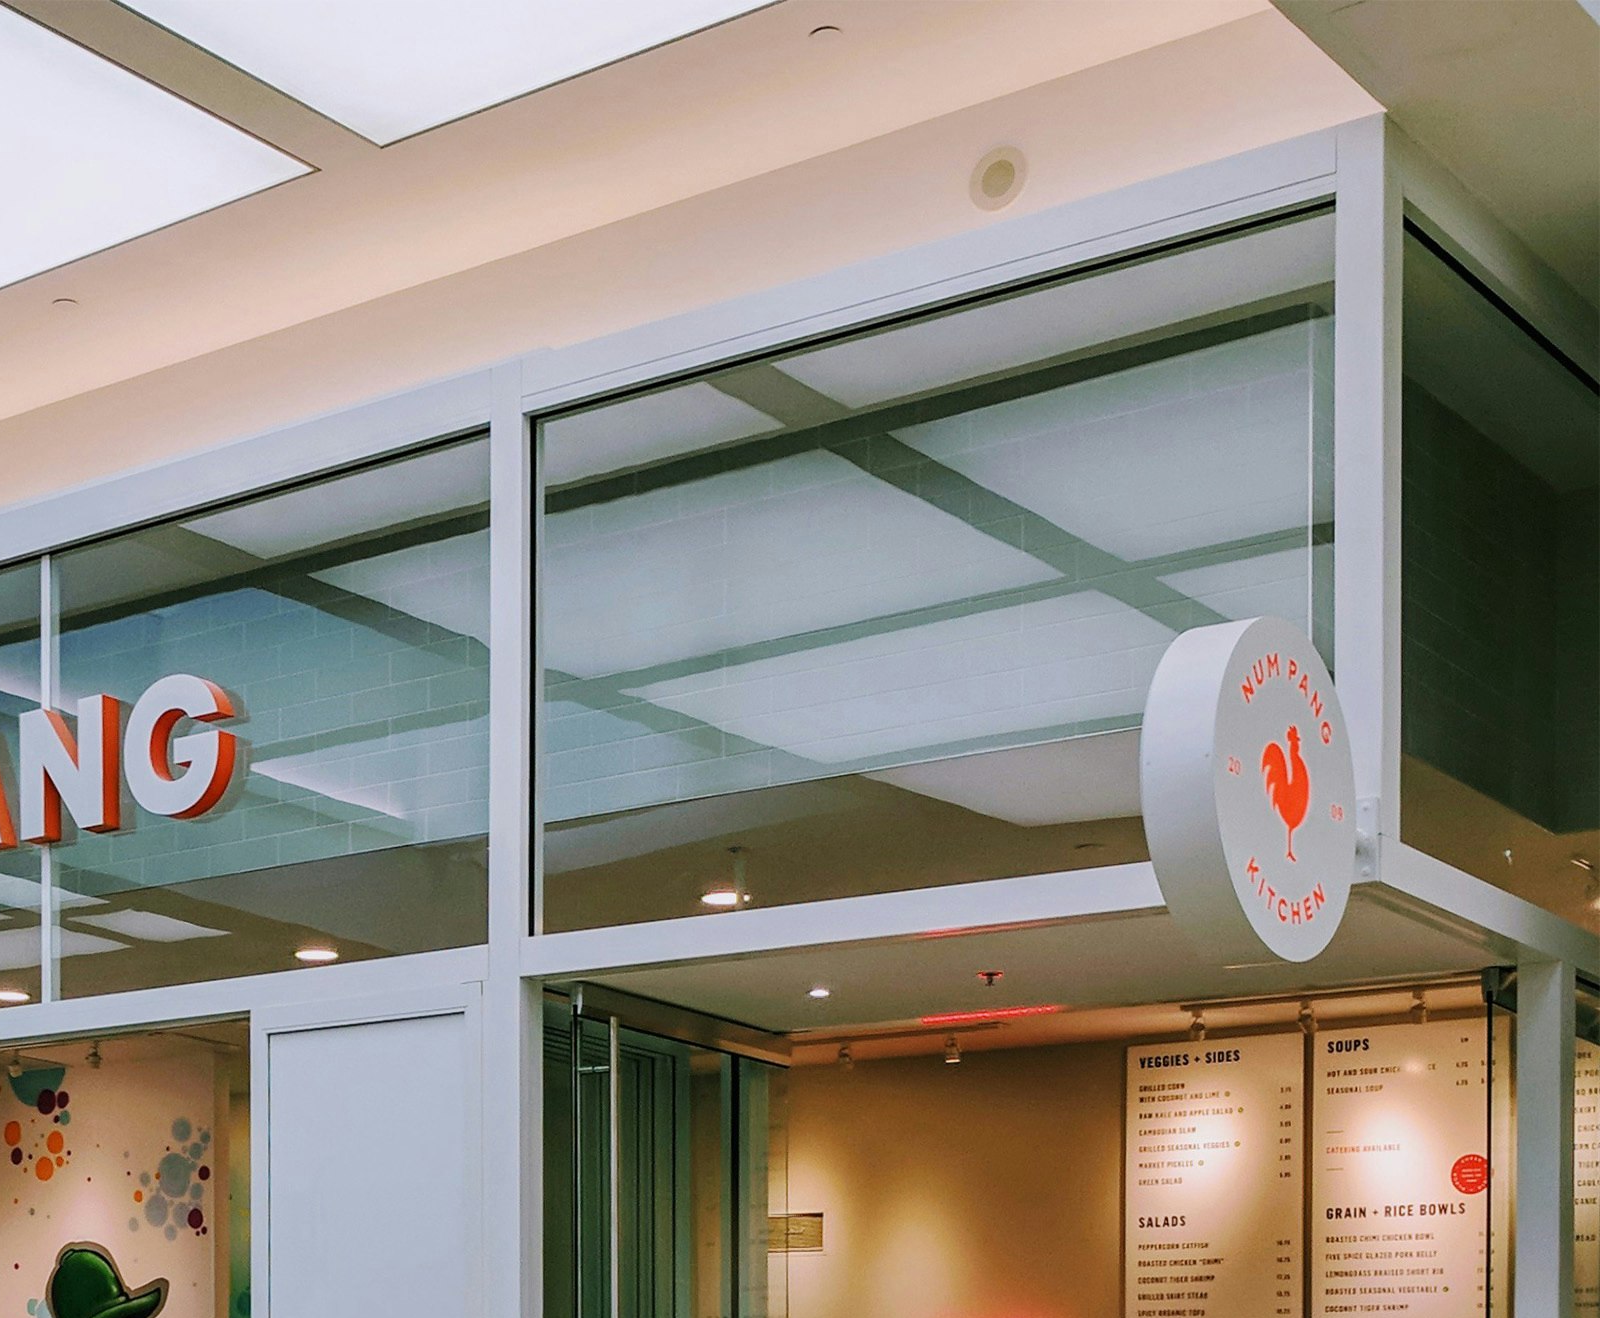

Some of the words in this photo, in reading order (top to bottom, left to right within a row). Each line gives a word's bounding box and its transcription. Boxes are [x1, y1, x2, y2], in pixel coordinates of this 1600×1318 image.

[1241, 652, 1280, 704] NUM
[1288, 659, 1333, 745] PANG
[1246, 856, 1326, 924] KITCHEN
[1327, 1038, 1370, 1054] SOUPS
[1139, 1054, 1190, 1069] VEGGIES
[1205, 1050, 1241, 1064] SIDES
[1327, 1069, 1341, 1078] HOT
[1343, 1068, 1357, 1076] AND
[1359, 1067, 1378, 1075] SOUR
[1326, 1085, 1362, 1095] SEASONAL
[1365, 1084, 1384, 1093] SOUP
[1167, 1143, 1201, 1152] SEASONAL
[1326, 1207, 1367, 1220] GRAIN
[1383, 1204, 1415, 1218] RICE
[1419, 1202, 1466, 1216] BOWLS
[1138, 1215, 1187, 1229] SALADS
[1138, 1243, 1180, 1251] PEPPERCORN
[1138, 1260, 1167, 1268] ROASTED
[1169, 1259, 1197, 1267] CHICKEN
[1359, 1286, 1396, 1295] SEASONAL
